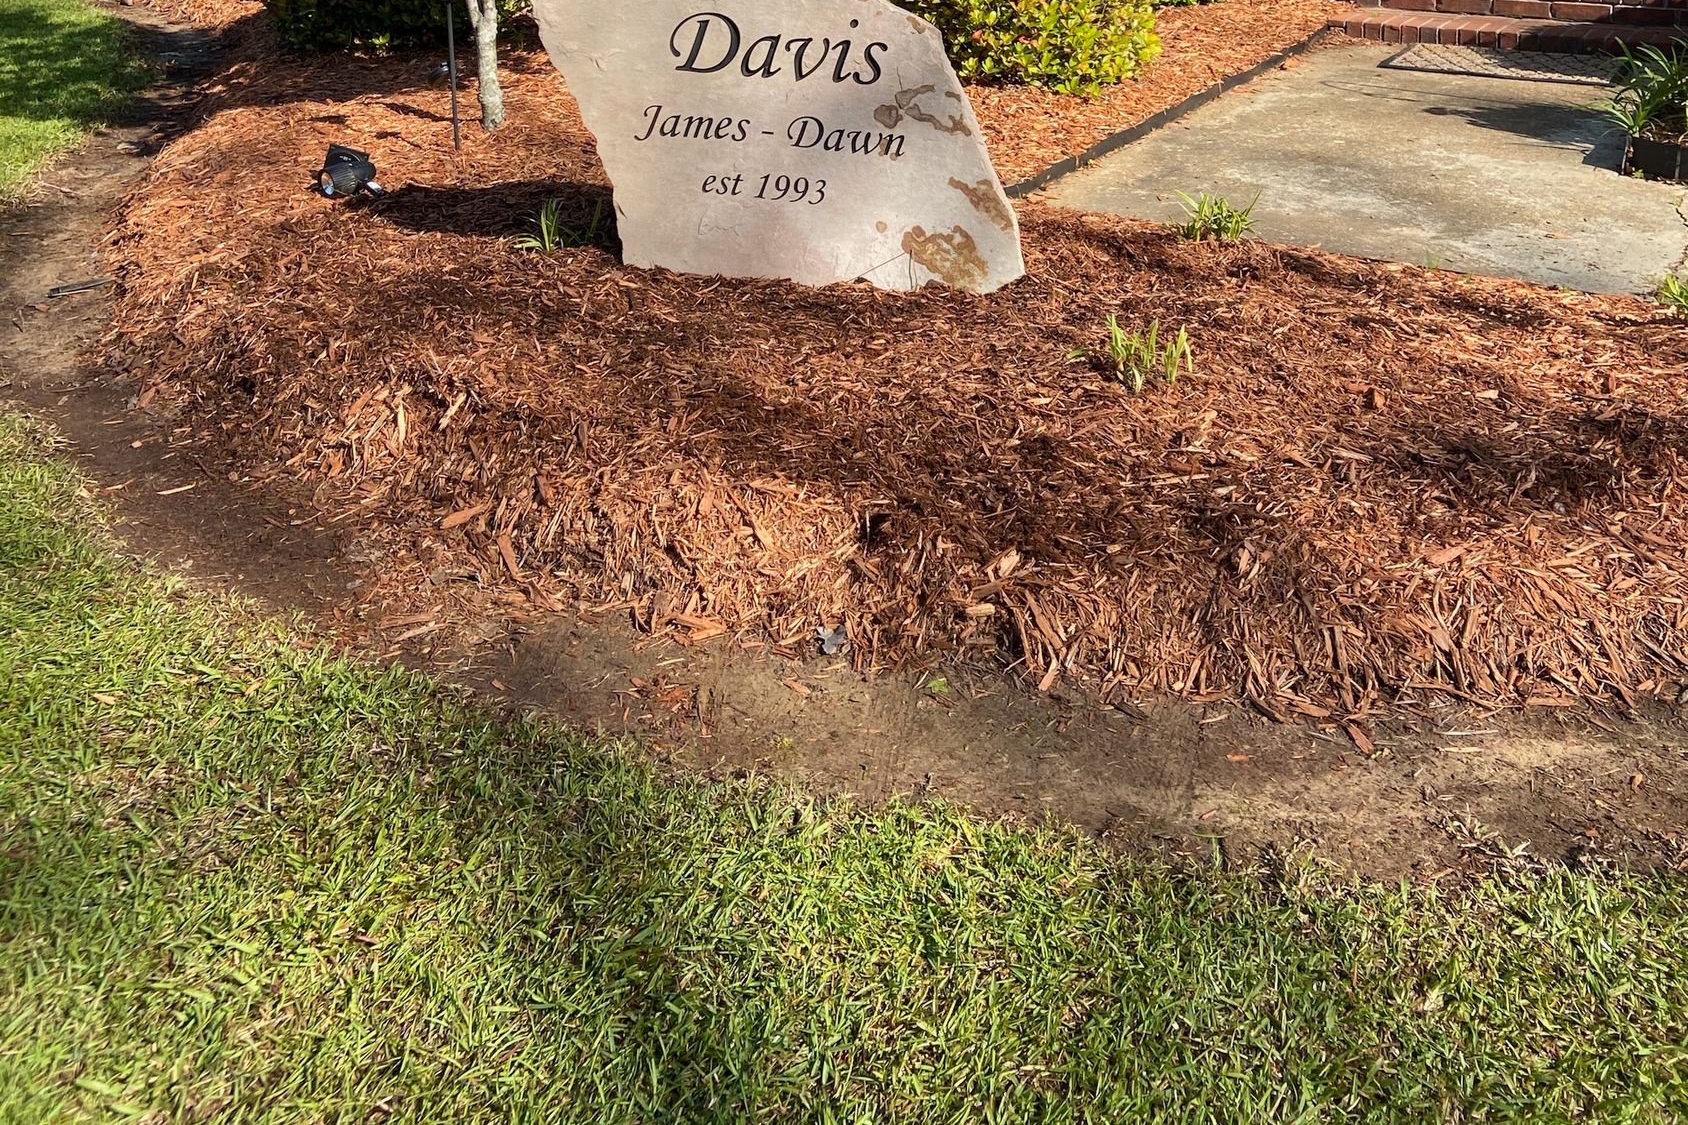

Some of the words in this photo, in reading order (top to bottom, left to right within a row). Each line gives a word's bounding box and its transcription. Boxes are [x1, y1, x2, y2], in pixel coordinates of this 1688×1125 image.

[669, 11, 889, 86] Davis
[633, 104, 751, 143] James
[787, 115, 906, 158] Dawn
[701, 173, 743, 196] est
[753, 172, 827, 206] 1993
